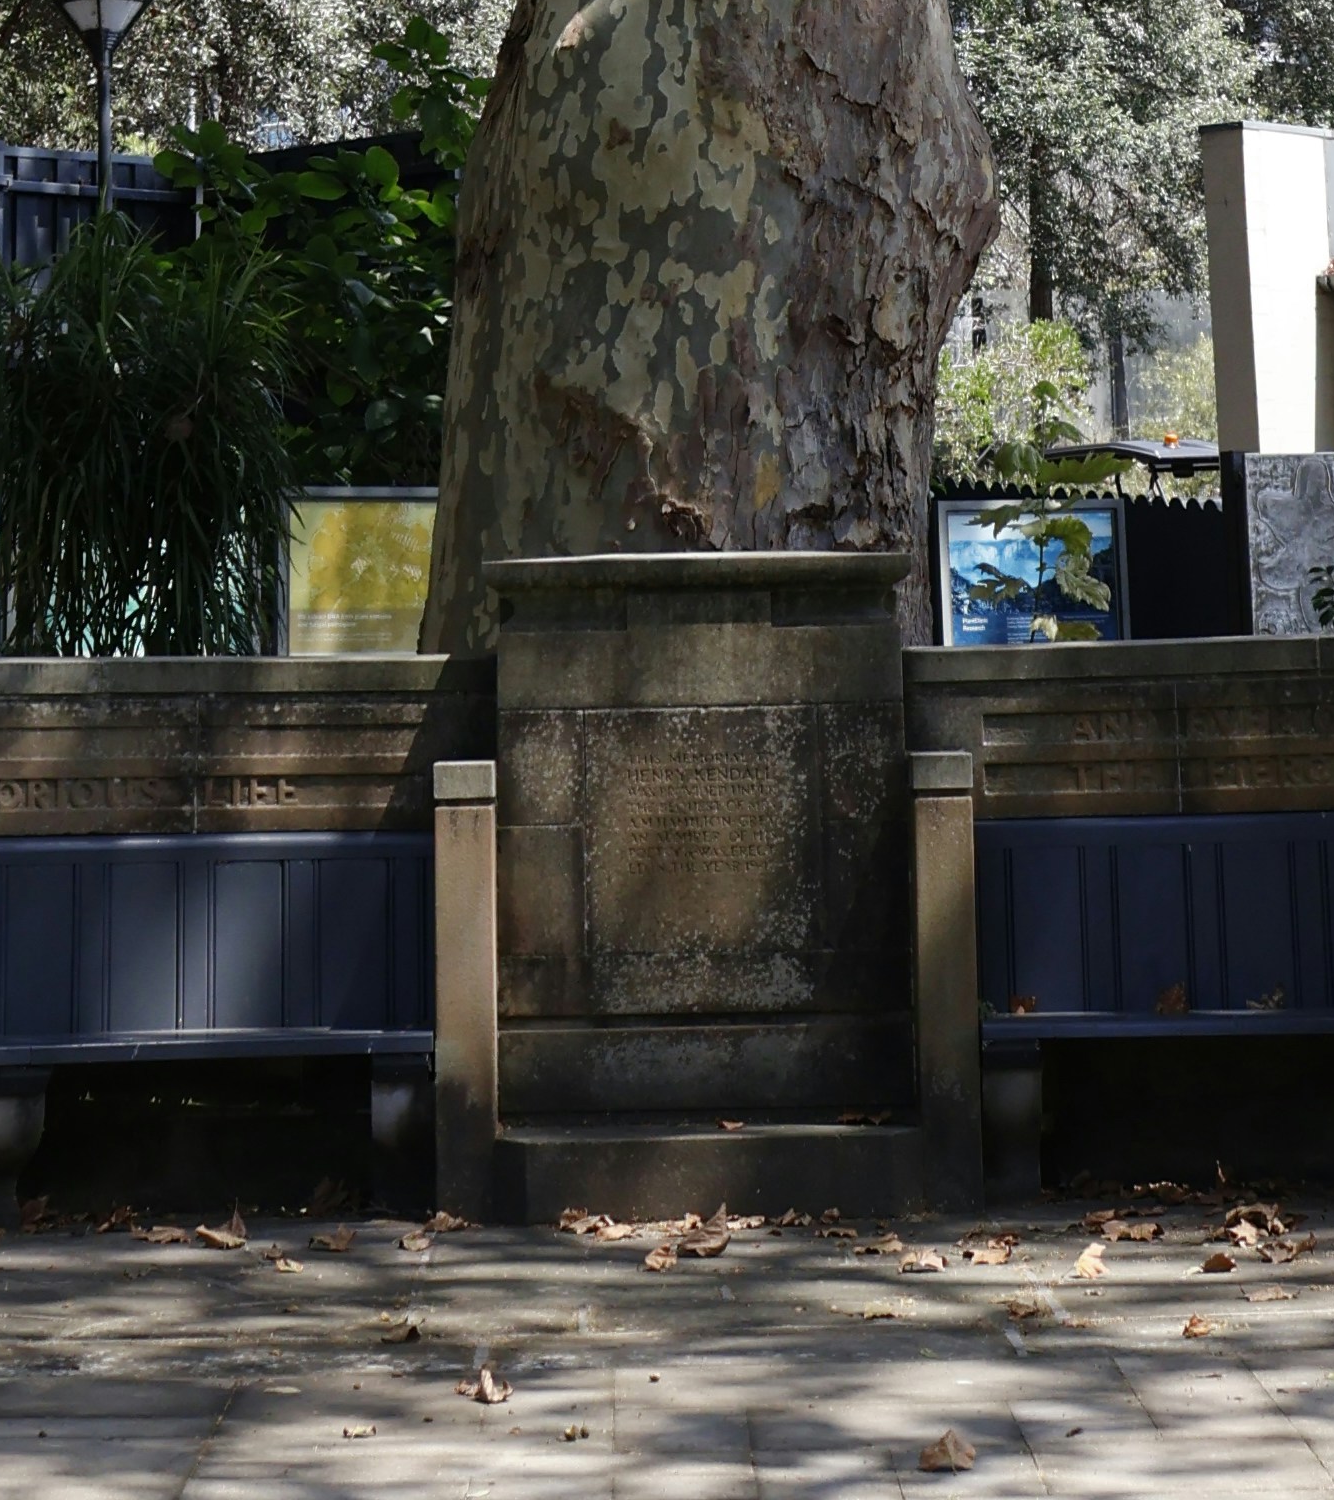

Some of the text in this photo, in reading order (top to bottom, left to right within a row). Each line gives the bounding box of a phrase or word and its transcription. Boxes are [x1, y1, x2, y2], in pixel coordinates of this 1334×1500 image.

[1073, 708, 1159, 741] AND
[1187, 704, 1312, 740] EVER
[628, 753, 662, 765] THIS
[669, 752, 748, 765] MEMORIAL
[626, 766, 774, 782] HENRY KENDALL
[1068, 761, 1160, 791] THE
[204, 776, 300, 807] LIFE
[726, 799, 744, 812] OF
[629, 832, 648, 845] AN
[728, 830, 745, 843] OF
